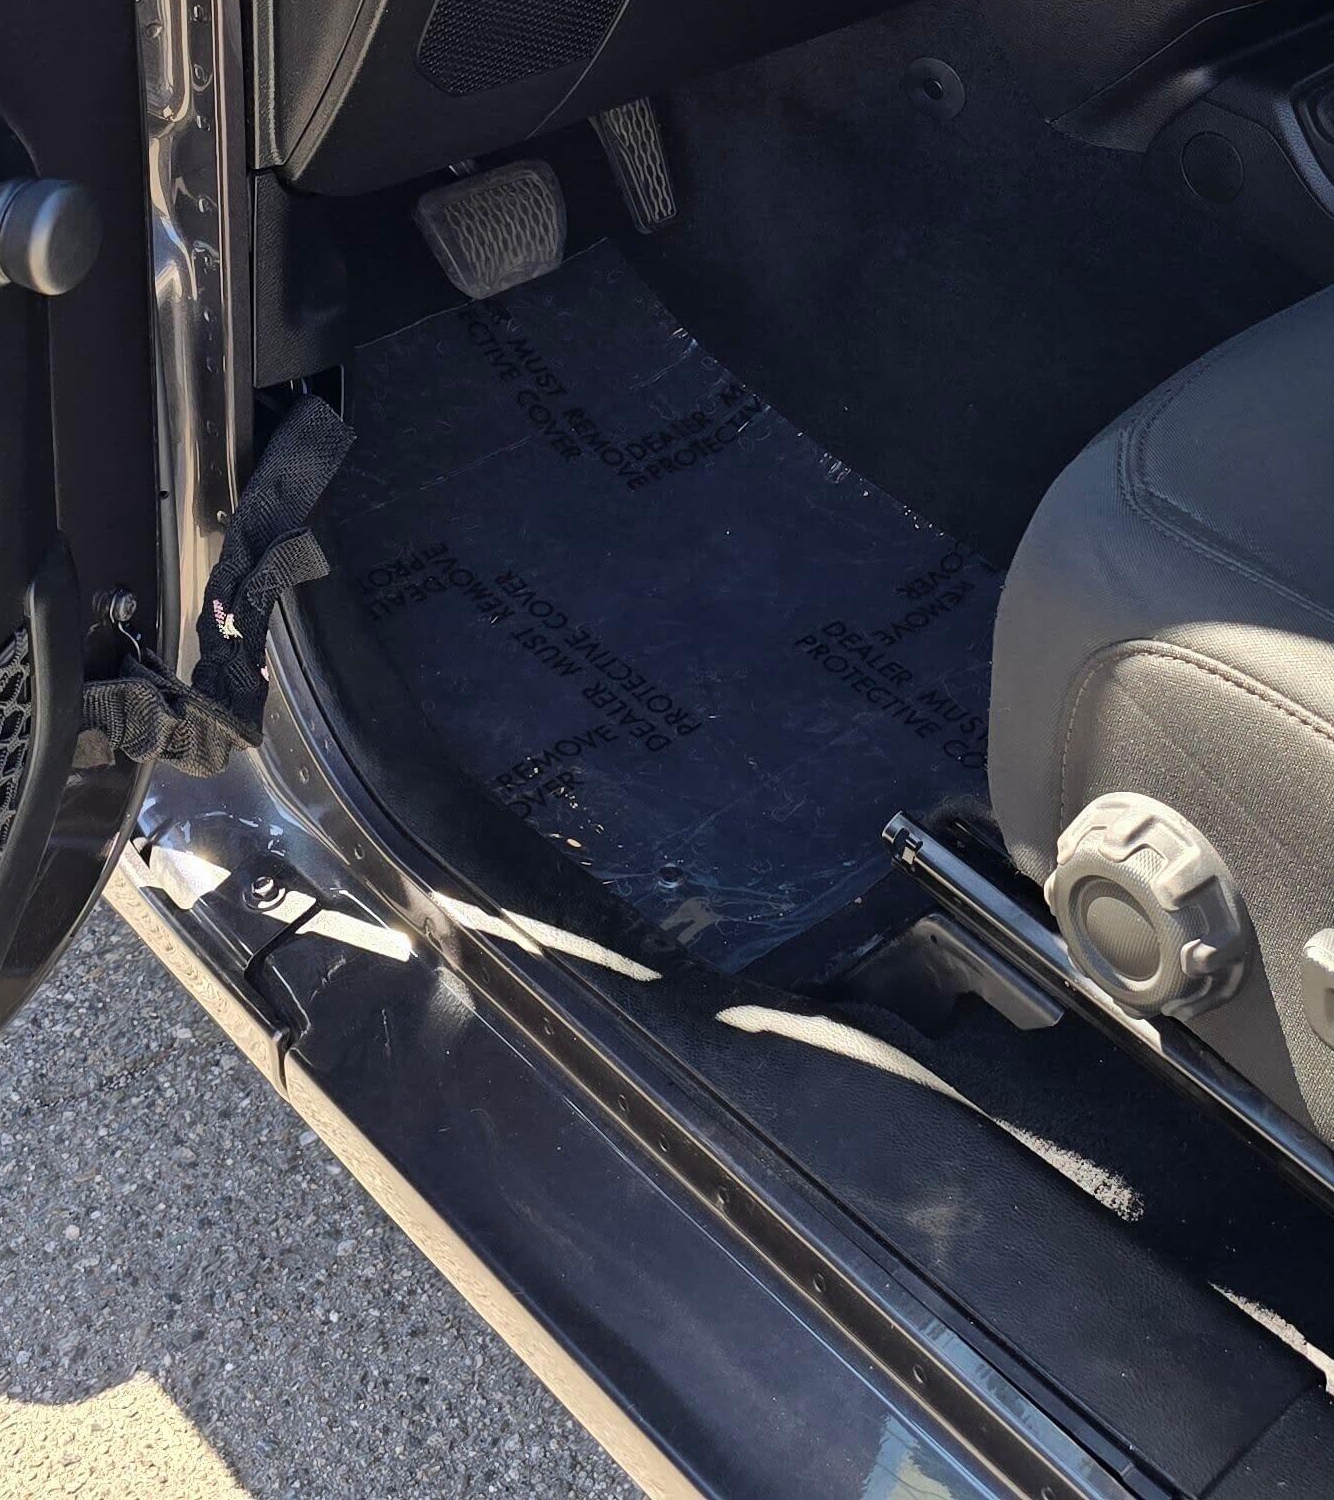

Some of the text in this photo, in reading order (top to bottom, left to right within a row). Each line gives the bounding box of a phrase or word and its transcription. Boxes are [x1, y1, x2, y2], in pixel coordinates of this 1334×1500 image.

[505, 338, 568, 397] MUST
[516, 389, 584, 462] COVER
[493, 570, 703, 736] PROTECTIVE COVER
[511, 627, 583, 677] MUST
[821, 620, 914, 688] DEALER
[581, 681, 673, 752] DEALER
[794, 634, 942, 740] PROTECTIVE
[495, 723, 619, 791] REMOVE
